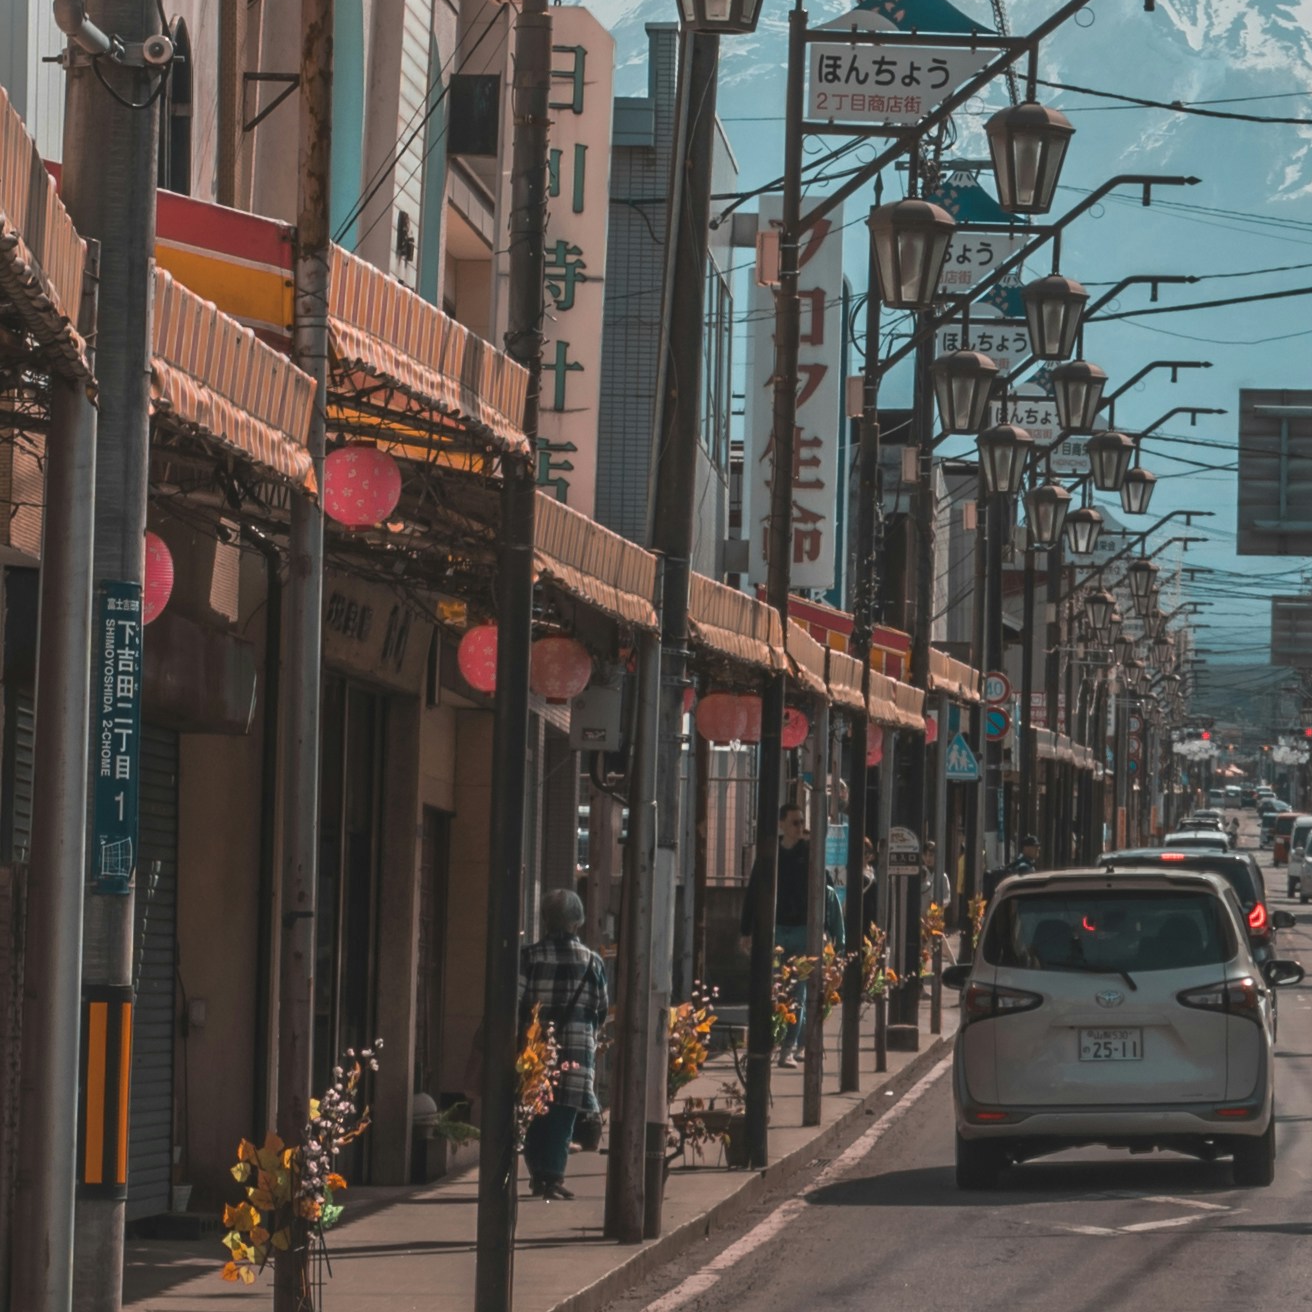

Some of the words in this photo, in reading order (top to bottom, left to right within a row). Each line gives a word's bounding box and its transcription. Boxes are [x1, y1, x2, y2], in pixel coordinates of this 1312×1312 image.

[818, 54, 950, 89] ほんちょう
[816, 92, 922, 114] 2丁目商店街
[102, 619, 116, 714] SHIMOYOSHIDA
[100, 720, 113, 777] 2-CHOME
[1093, 1041, 1137, 1058] 25-11
